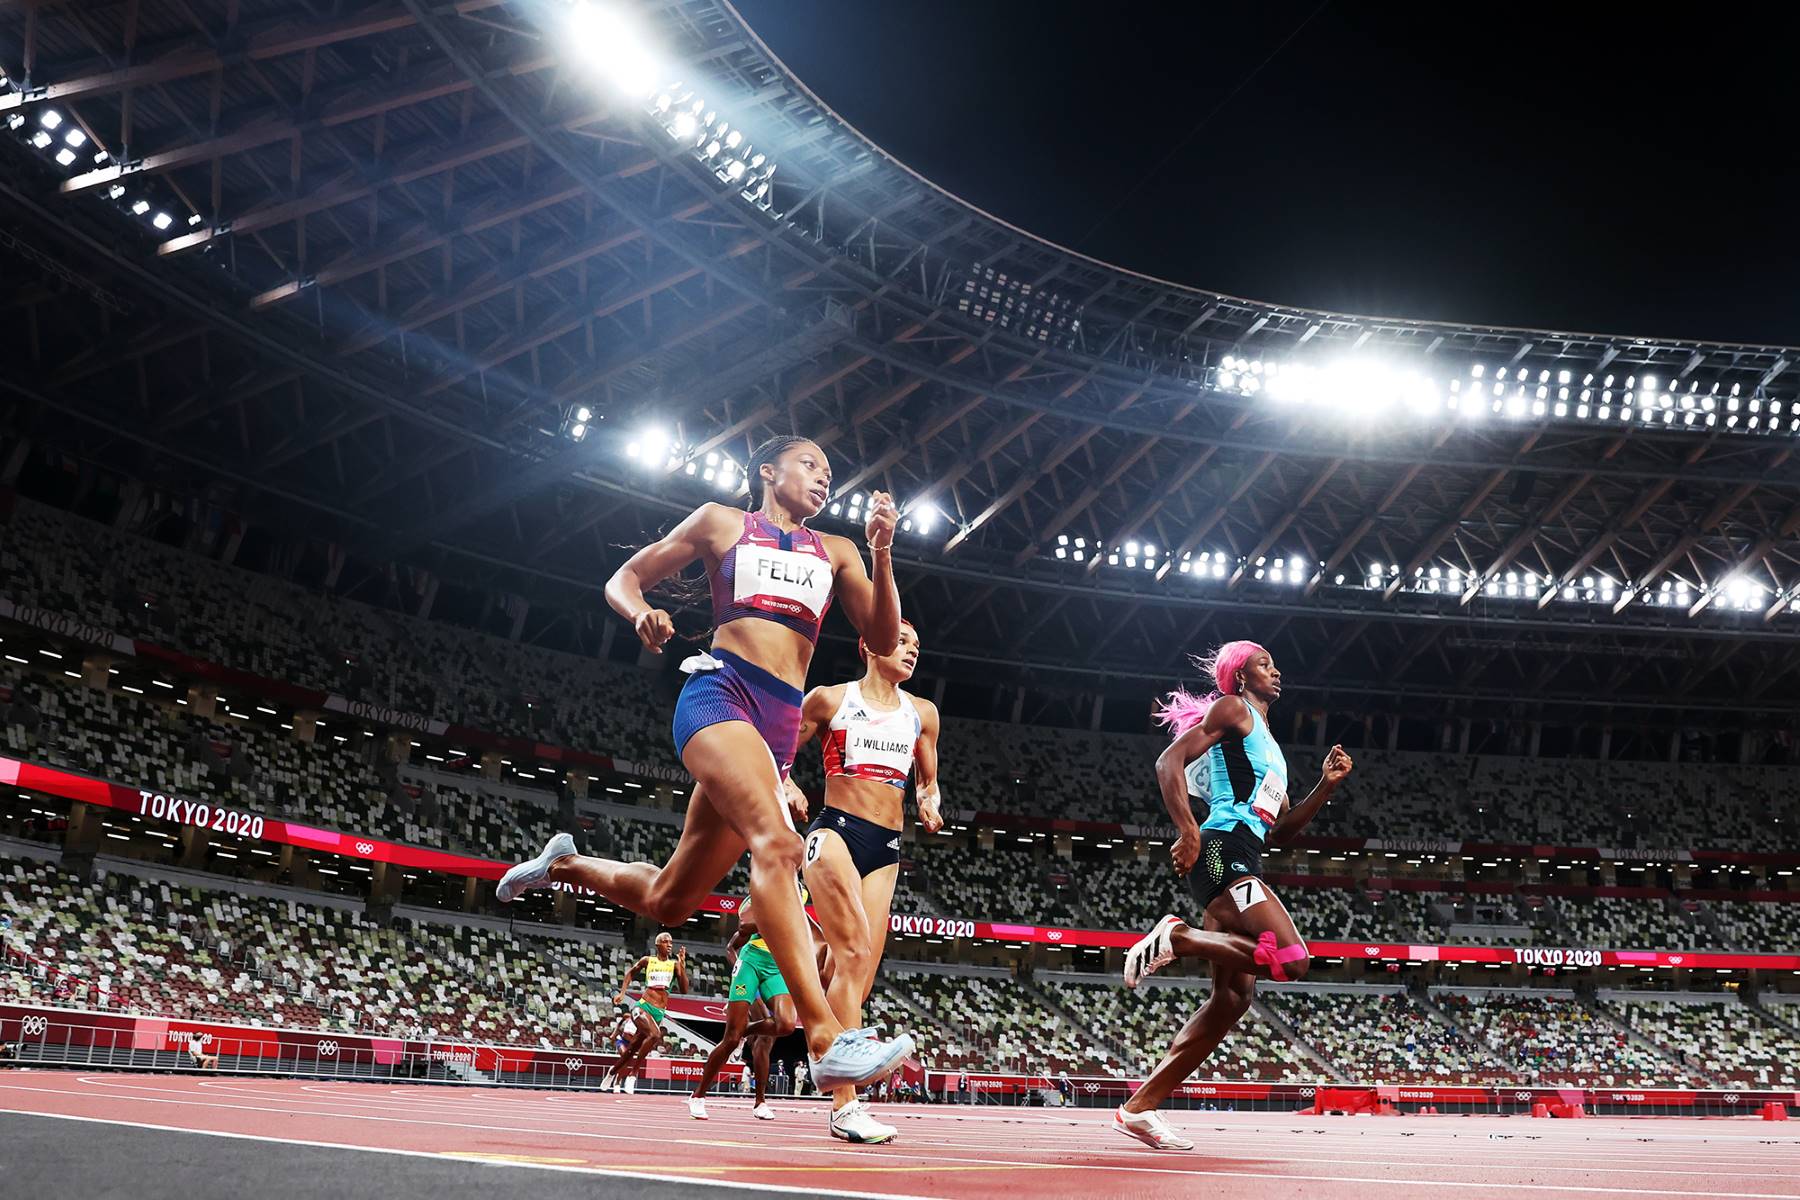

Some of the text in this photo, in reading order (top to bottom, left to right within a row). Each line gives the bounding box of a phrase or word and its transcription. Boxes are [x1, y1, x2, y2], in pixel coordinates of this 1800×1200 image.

[757, 558, 815, 589] FELIX
[12, 602, 114, 648] TOKYO 2020
[346, 699, 430, 732] TOKYO 2020
[631, 760, 672, 781] TOKYO
[140, 790, 264, 839] TOKYO 2020
[807, 836, 818, 861] 8
[1380, 838, 1448, 853] TOKYO 2020
[1236, 881, 1252, 904] 7
[889, 914, 975, 938] OKYO 2020
[1514, 948, 1602, 967] TOKYO 2020
[168, 1030, 194, 1043] TOKYO
[455, 1052, 472, 1062] 2020
[692, 1067, 704, 1076] 202
